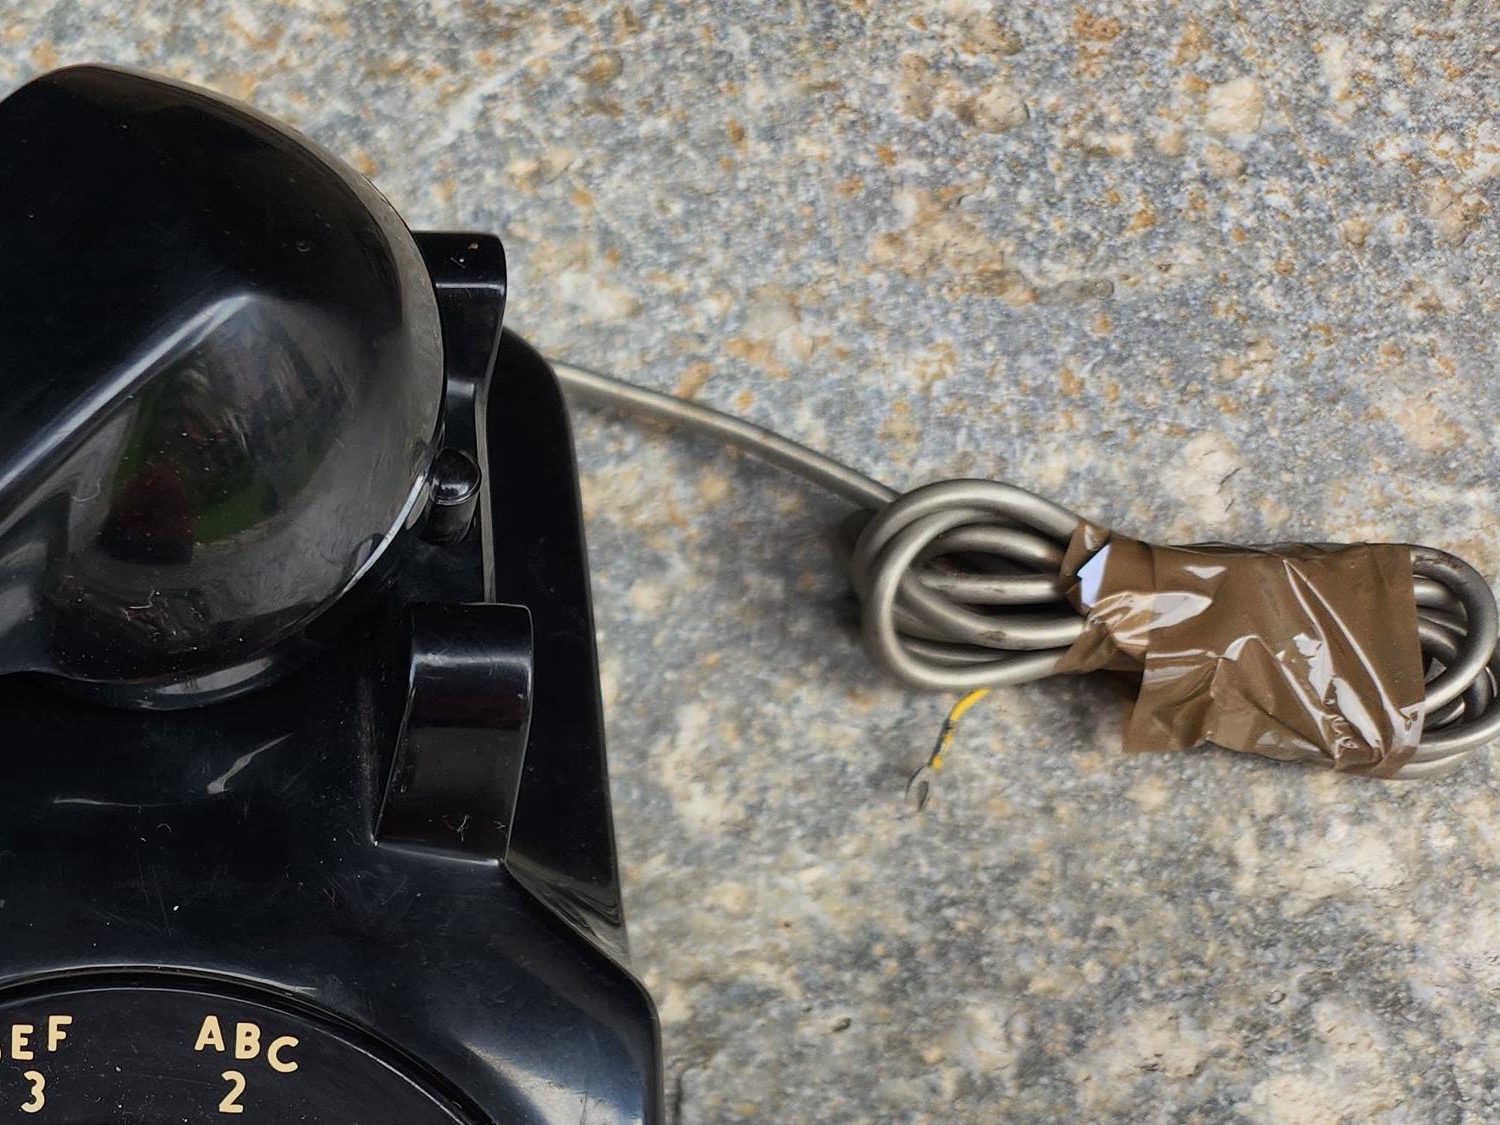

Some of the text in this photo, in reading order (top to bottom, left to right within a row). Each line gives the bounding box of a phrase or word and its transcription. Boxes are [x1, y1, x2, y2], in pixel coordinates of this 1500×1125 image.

[194, 1015, 299, 1073] ABC
[21, 1070, 46, 1113] 3
[218, 1070, 246, 1113] 2
